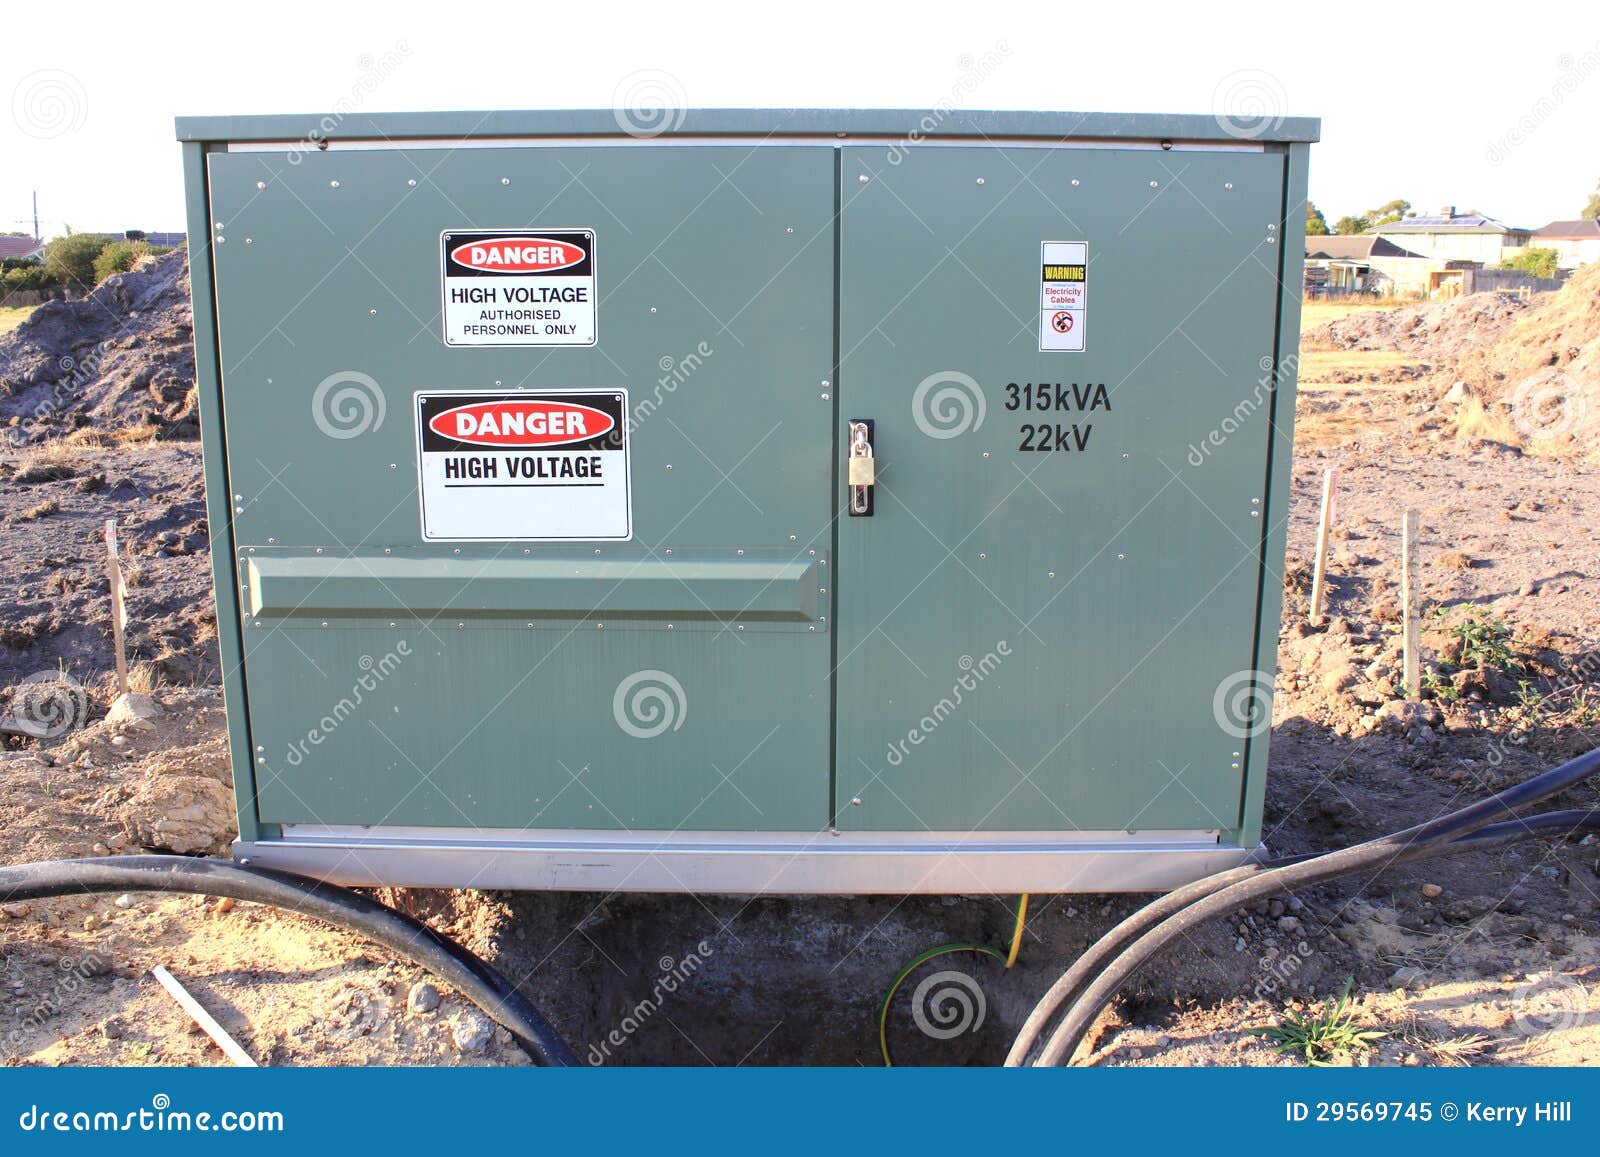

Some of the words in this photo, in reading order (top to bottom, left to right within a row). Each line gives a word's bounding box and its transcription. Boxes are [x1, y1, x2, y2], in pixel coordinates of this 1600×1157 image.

[471, 246, 566, 265] DANGER
[1044, 266, 1084, 280] WARNING
[451, 288, 496, 303] HIGH
[503, 287, 588, 303] VOLTAGE
[1045, 287, 1081, 296] Electricity
[1050, 296, 1075, 304] Cables
[480, 309, 561, 320] AUTHORISED
[464, 325, 539, 335] PERSONNEL
[545, 324, 577, 335] ONLY
[1004, 382, 1112, 411] 315kVA
[456, 411, 587, 436] DANGER
[1019, 424, 1092, 452] 22kV
[445, 457, 498, 479] HIGH
[505, 456, 603, 478] VOLTAGE
